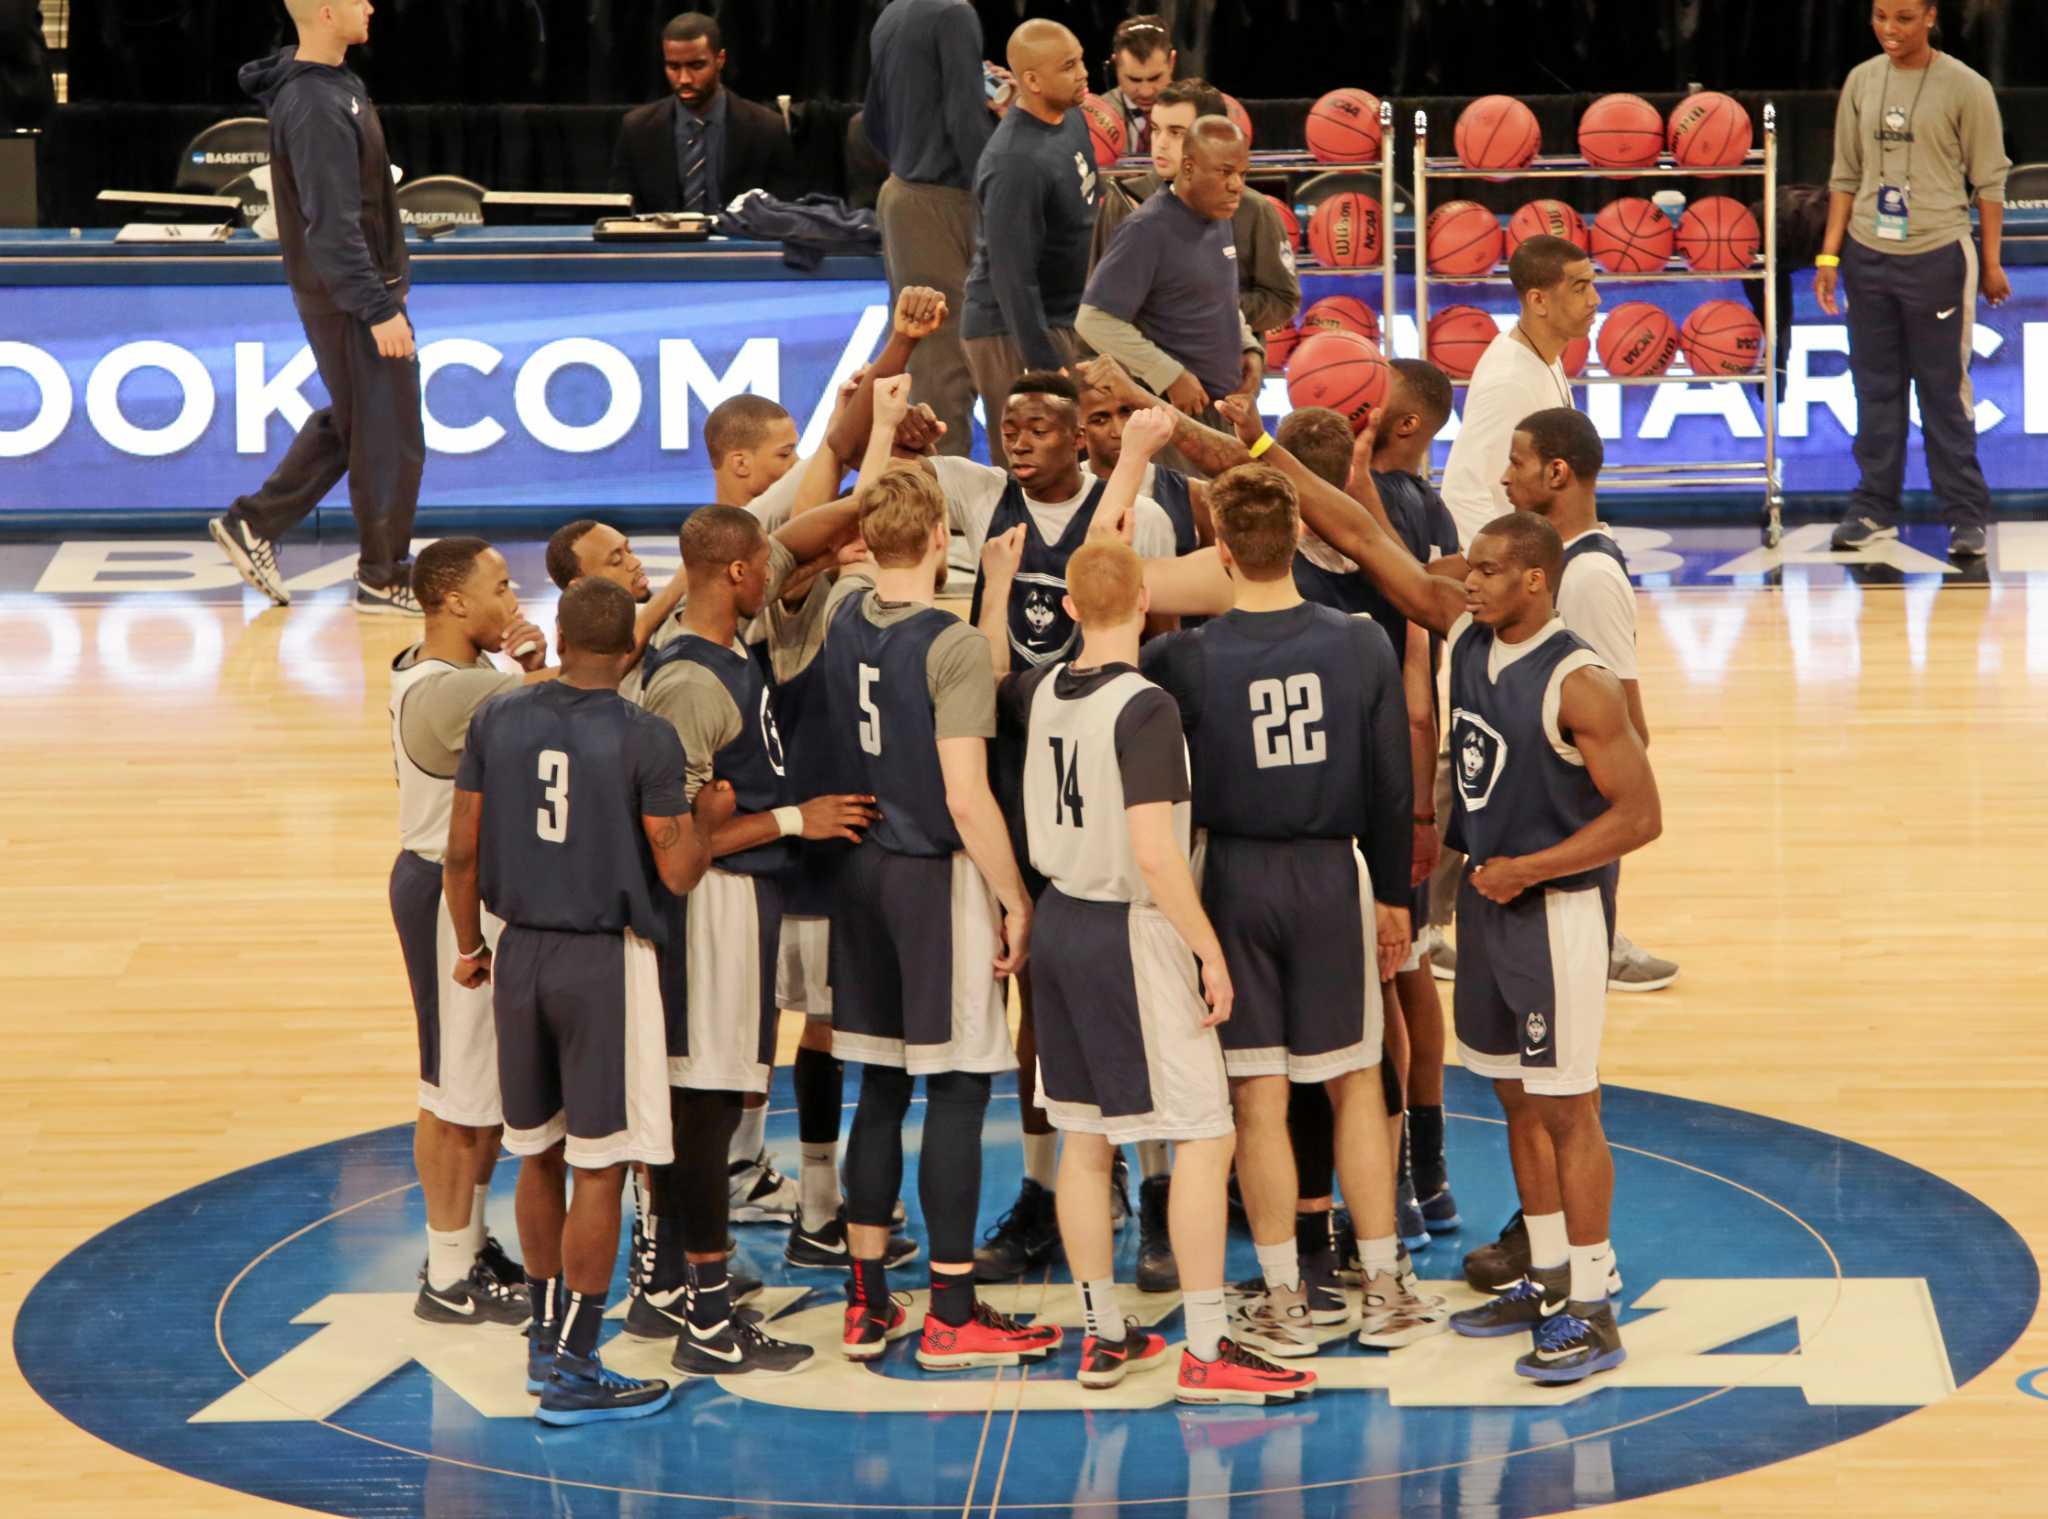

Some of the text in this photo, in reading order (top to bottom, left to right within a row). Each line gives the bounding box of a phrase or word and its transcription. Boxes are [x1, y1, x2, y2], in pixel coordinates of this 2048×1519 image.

[1335, 201, 1352, 256] Wilson
[858, 662, 881, 756] 5
[1248, 672, 1327, 769] 22
[536, 749, 569, 843] 3
[1048, 736, 1084, 828] 14
